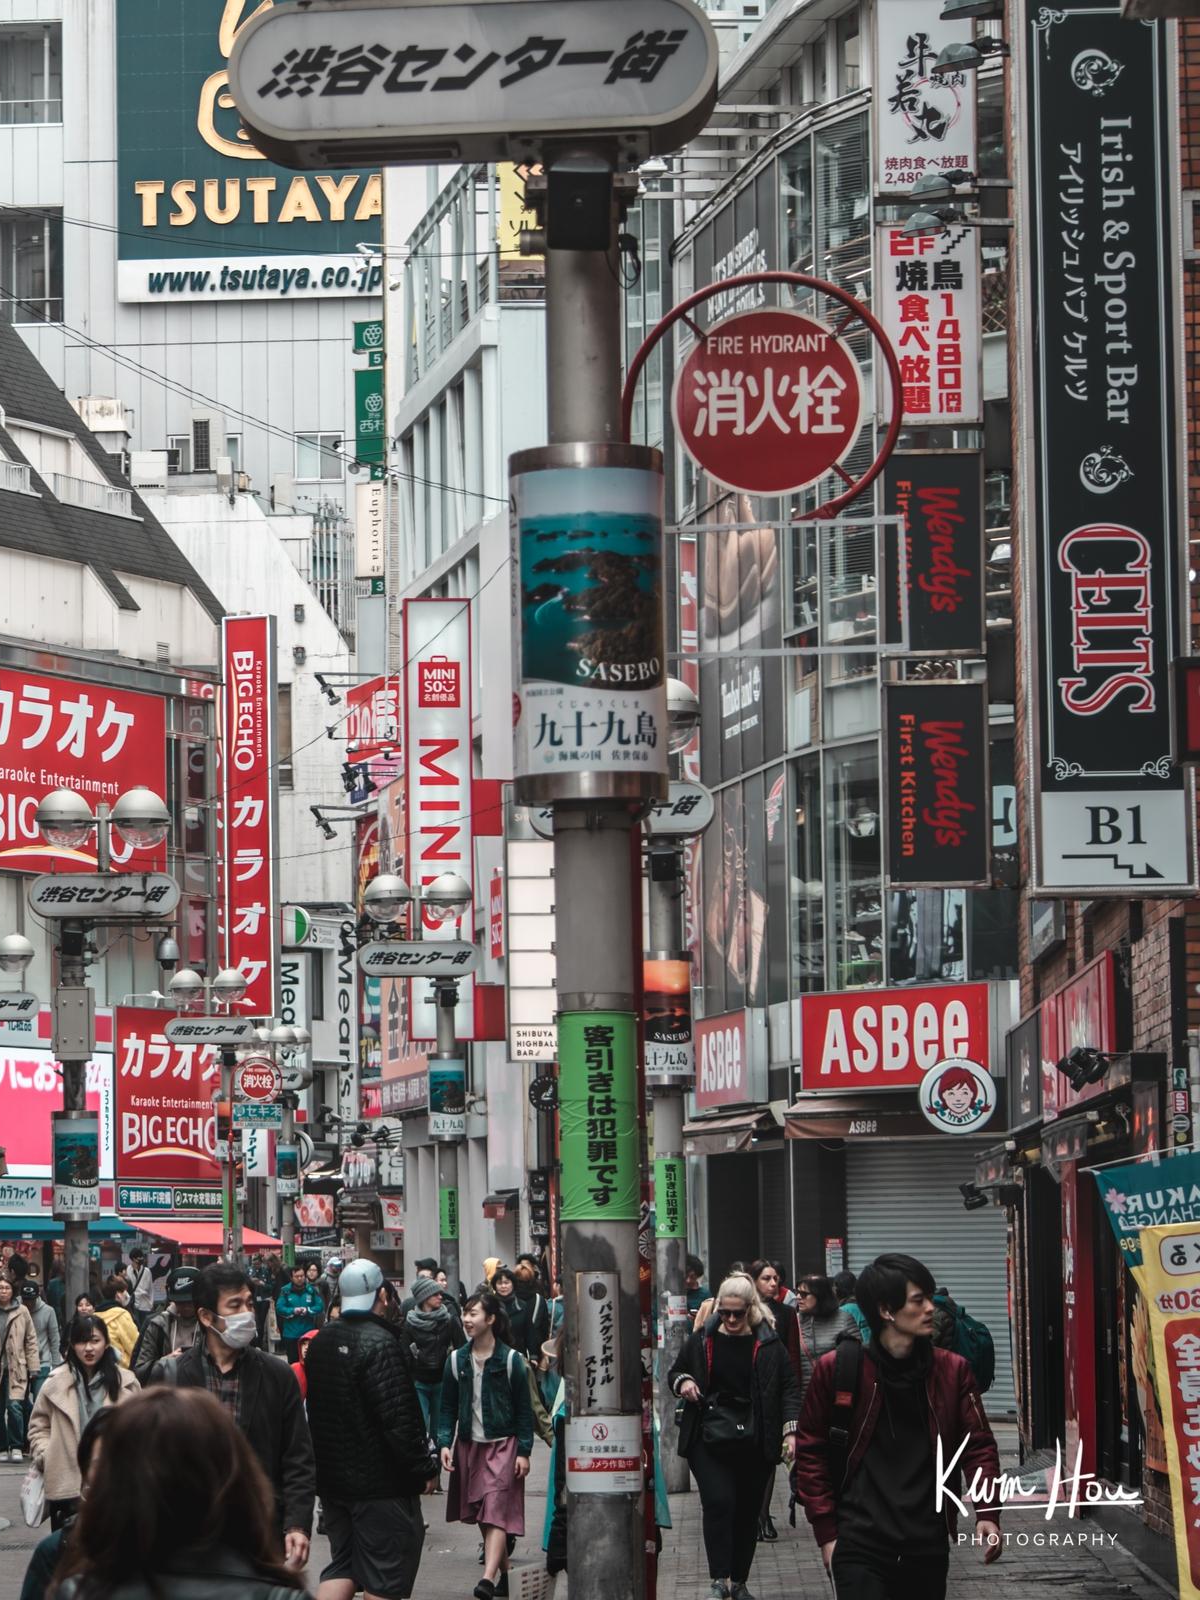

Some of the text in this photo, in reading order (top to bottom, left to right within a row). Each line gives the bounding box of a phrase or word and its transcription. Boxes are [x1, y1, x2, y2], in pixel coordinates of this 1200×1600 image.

[257, 30, 688, 98] 渋谷センター街
[885, 156, 968, 170] 焼肉食べ放題
[135, 174, 382, 226] TSUTAYA
[890, 230, 934, 256] 2F
[147, 265, 382, 294] www.tsutaya.co.jp
[896, 260, 963, 291] 焼鳥
[1058, 142, 1089, 400] アイリッシュパブ ケルツ
[1094, 116, 1139, 425] Irish & Sport Bar
[707, 333, 829, 355] FIRE HYDRANT
[898, 294, 931, 414] 食べ放題
[693, 365, 847, 436] 消火栓
[371, 488, 381, 560] Euphoria
[916, 487, 972, 613] Wendy's
[1057, 523, 1156, 716] CELTS
[424, 668, 455, 679] MINI
[576, 657, 660, 682] SASEBO
[533, 711, 658, 749] 九十九島
[558, 748, 601, 760] 海風の国
[40, 769, 119, 796] Entertainment
[900, 714, 916, 856] First Kitchen
[920, 720, 976, 847] Wendy's
[1085, 804, 1147, 846] B1
[37, 886, 170, 902] 渋谷センター街
[232, 796, 266, 985] カラオケ
[366, 951, 471, 966] 渋谷センター街
[172, 1026, 246, 1036] 渋谷センター街
[654, 1031, 689, 1041] SASEBO
[821, 1000, 969, 1075] ASBee
[700, 1027, 741, 1092] ASBee
[243, 1074, 273, 1089] 消火栓
[131, 1096, 213, 1109] Karaoke Entertainment
[584, 1025, 618, 1207] 客引きは犯罪です
[122, 1113, 163, 1154] BIG
[849, 1119, 877, 1133] ASBee
[59, 1194, 97, 1207] 九十九島
[664, 1164, 678, 1232] 客引きは犯罪です
[599, 1301, 615, 1386] バスケットボール
[584, 1355, 598, 1408] ストリート
